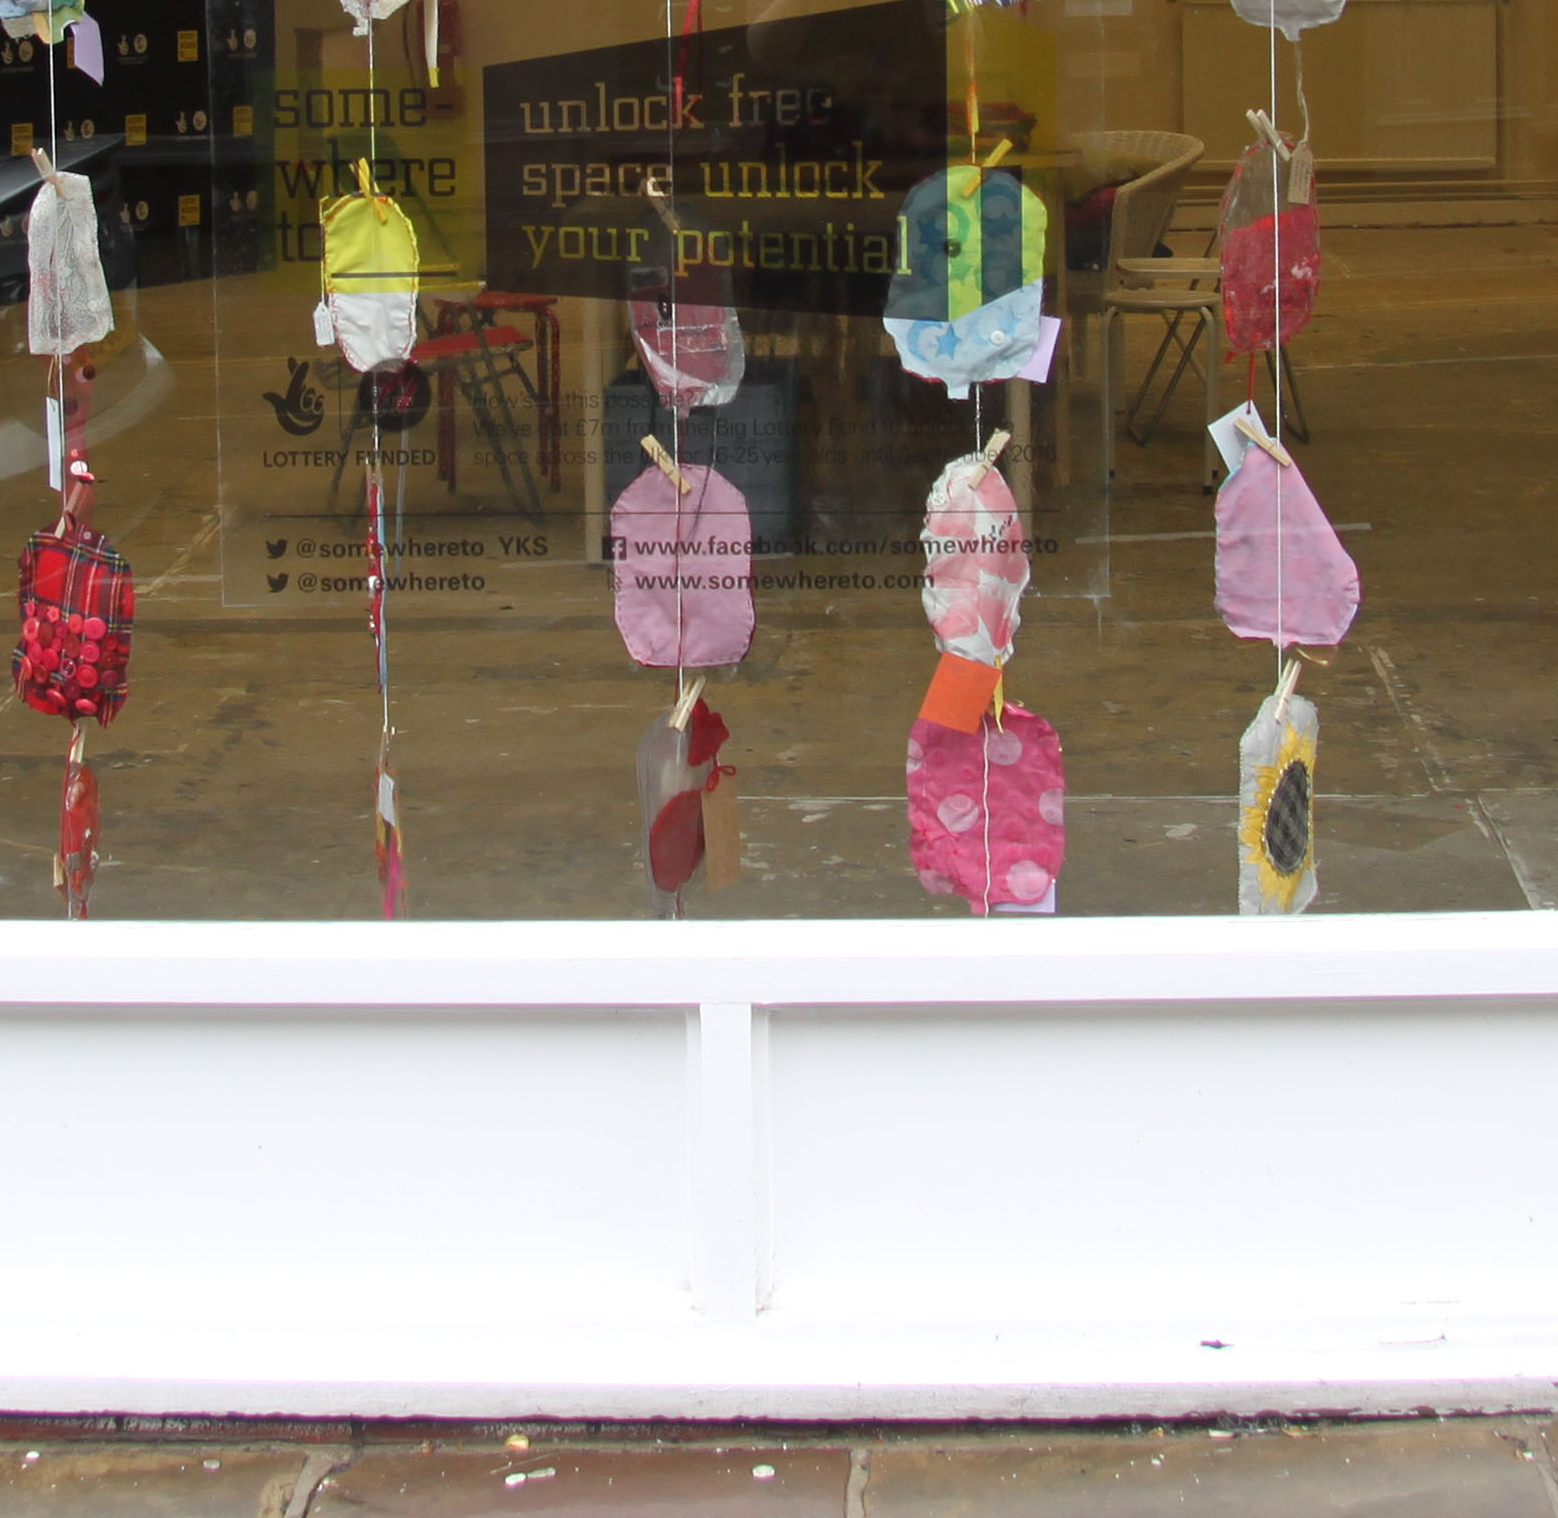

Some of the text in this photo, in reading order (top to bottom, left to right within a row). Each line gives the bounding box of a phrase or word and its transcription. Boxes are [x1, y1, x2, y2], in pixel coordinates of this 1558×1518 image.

[273, 86, 454, 129] some-
[520, 72, 833, 134] unlock free
[276, 138, 457, 200] where
[522, 140, 885, 208] space unlock
[522, 215, 913, 278] your potential
[263, 450, 347, 468] LOTTERY
[635, 570, 936, 591] www.somewhereto.com
